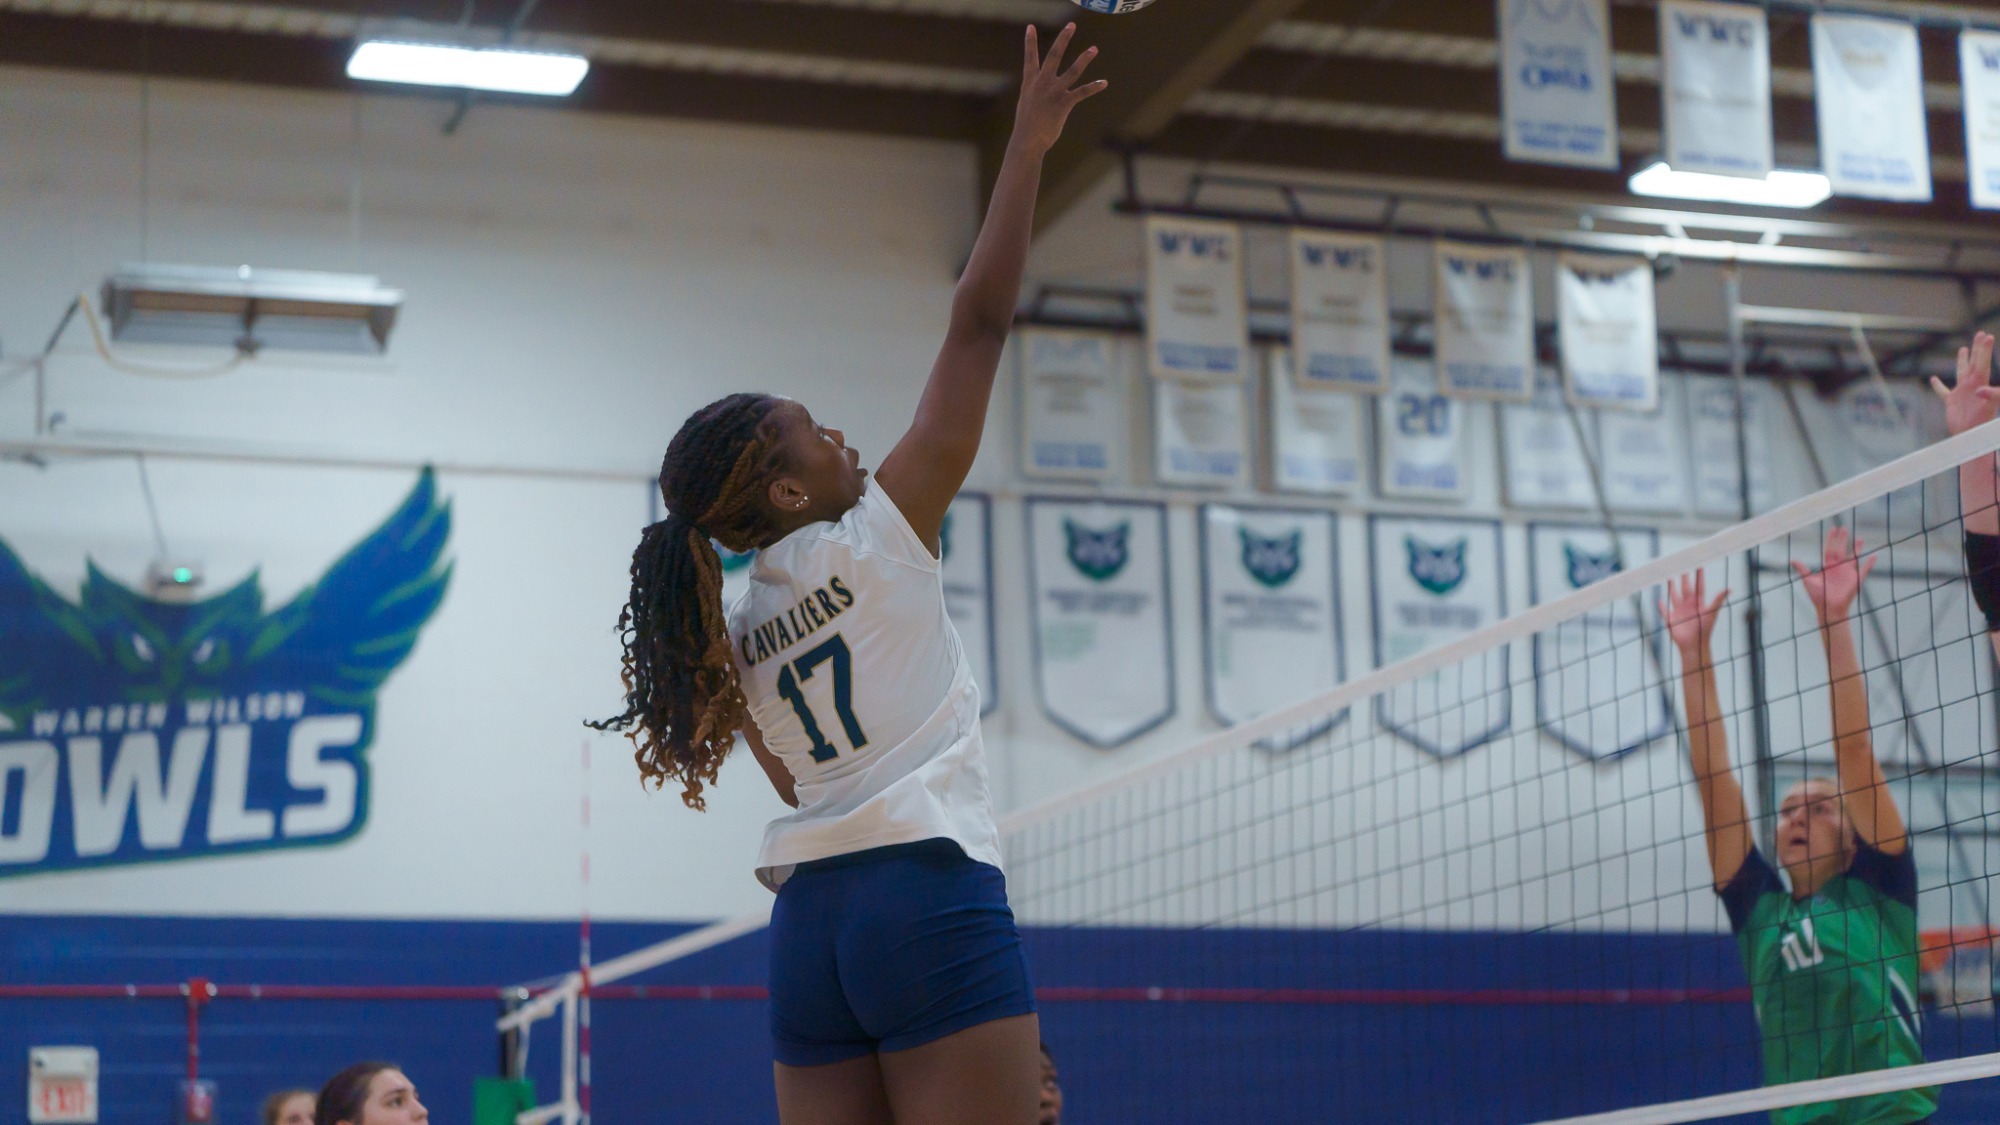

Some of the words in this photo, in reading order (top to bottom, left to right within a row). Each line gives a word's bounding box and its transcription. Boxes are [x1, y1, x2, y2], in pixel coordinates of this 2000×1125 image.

[741, 575, 855, 667] CAVALIERS
[32, 705, 168, 736] WARREN
[185, 691, 305, 724] WILSON
[777, 631, 869, 764] 17
[0, 714, 363, 863] OWLS
